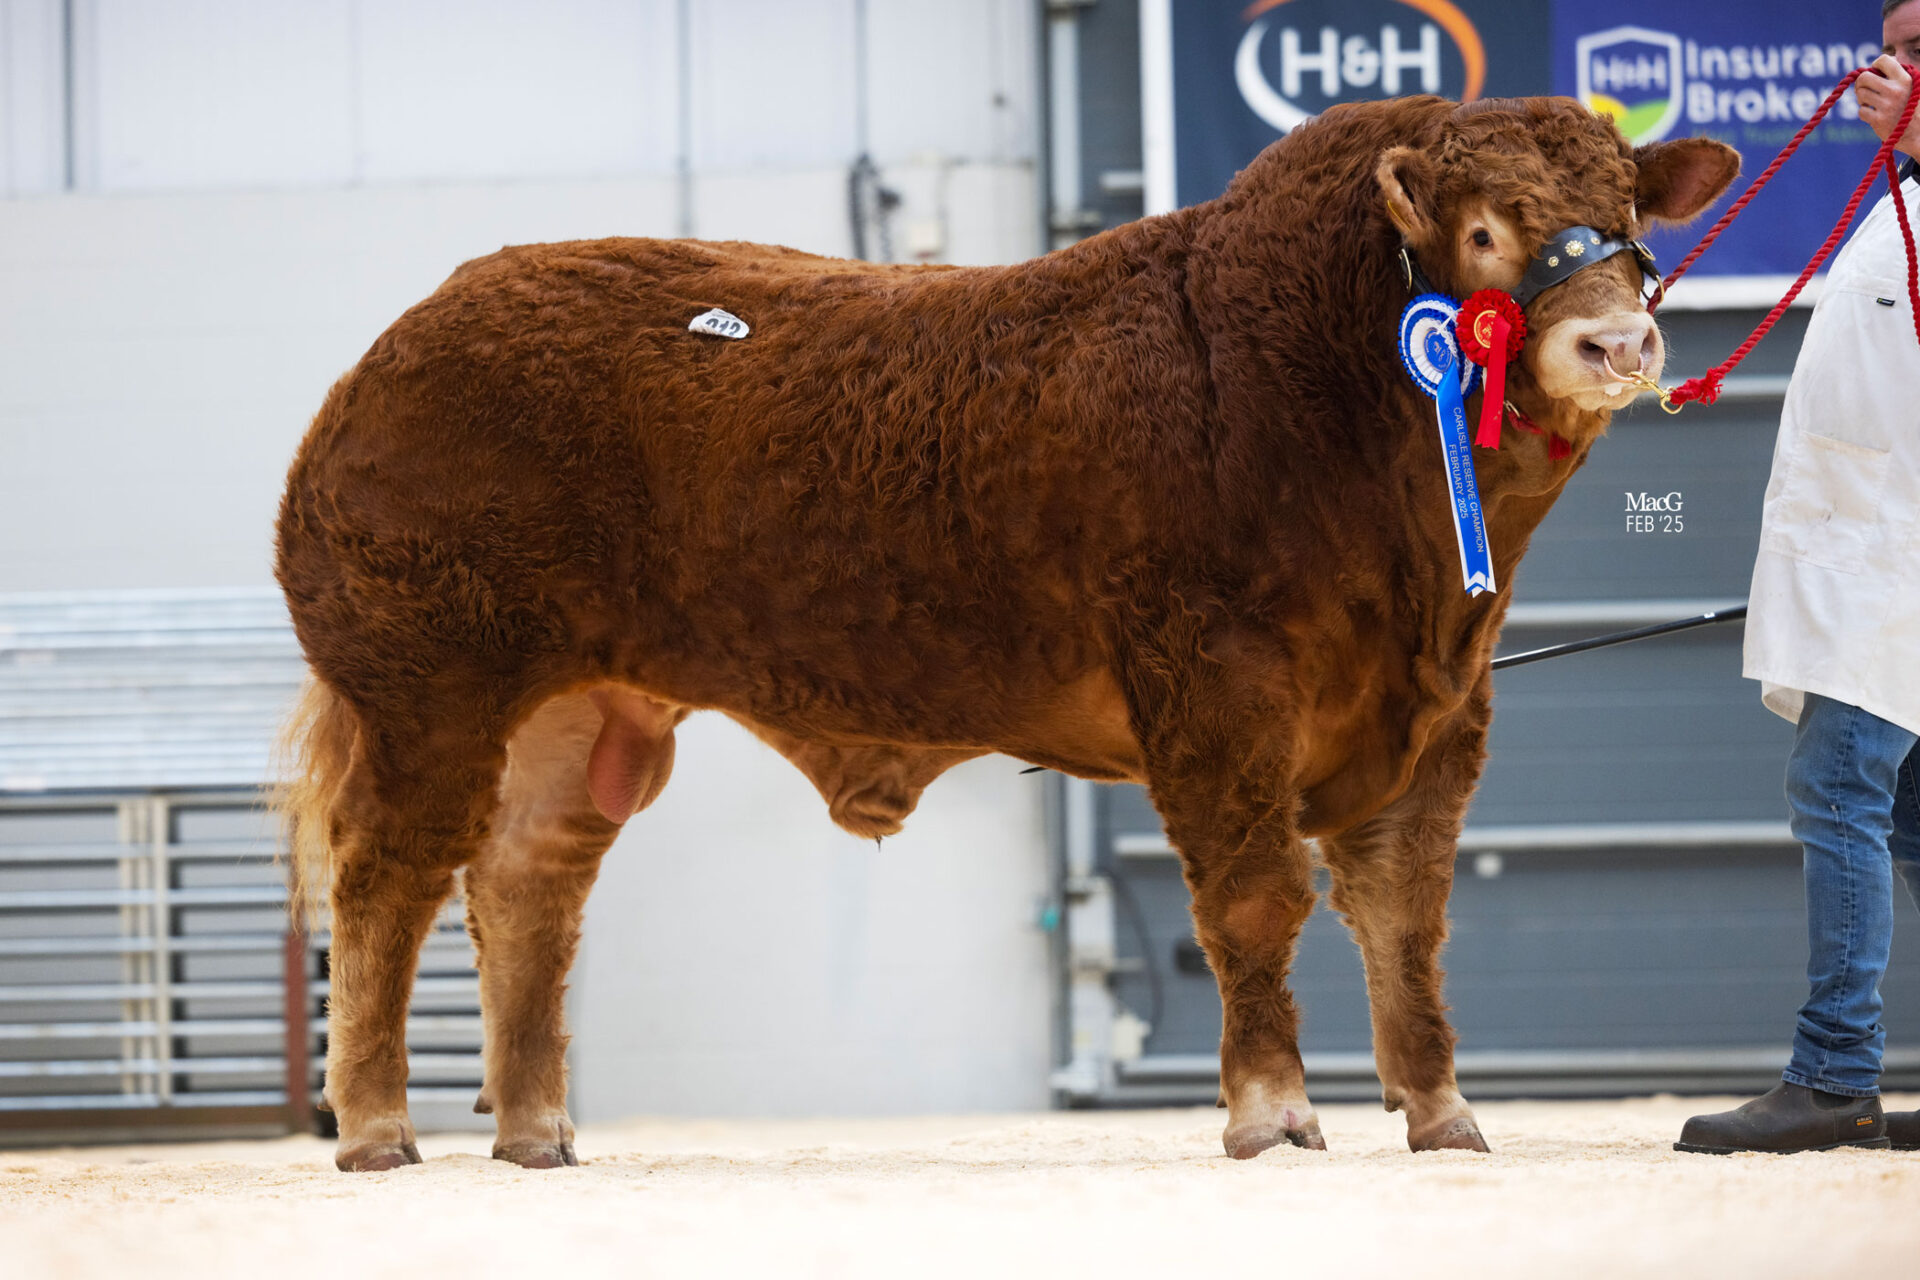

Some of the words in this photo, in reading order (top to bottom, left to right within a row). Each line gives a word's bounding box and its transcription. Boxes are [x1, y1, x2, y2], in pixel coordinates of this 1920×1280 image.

[1281, 25, 1440, 97] H&H
[1686, 39, 1882, 79] Insuranc
[1449, 444, 1464, 496] FEBRUARY
[1457, 498, 1469, 519] 2025
[1453, 407, 1468, 453] CARLISLE
[1462, 454, 1476, 500] RESERVE
[1470, 502, 1485, 552] CHAMPION
